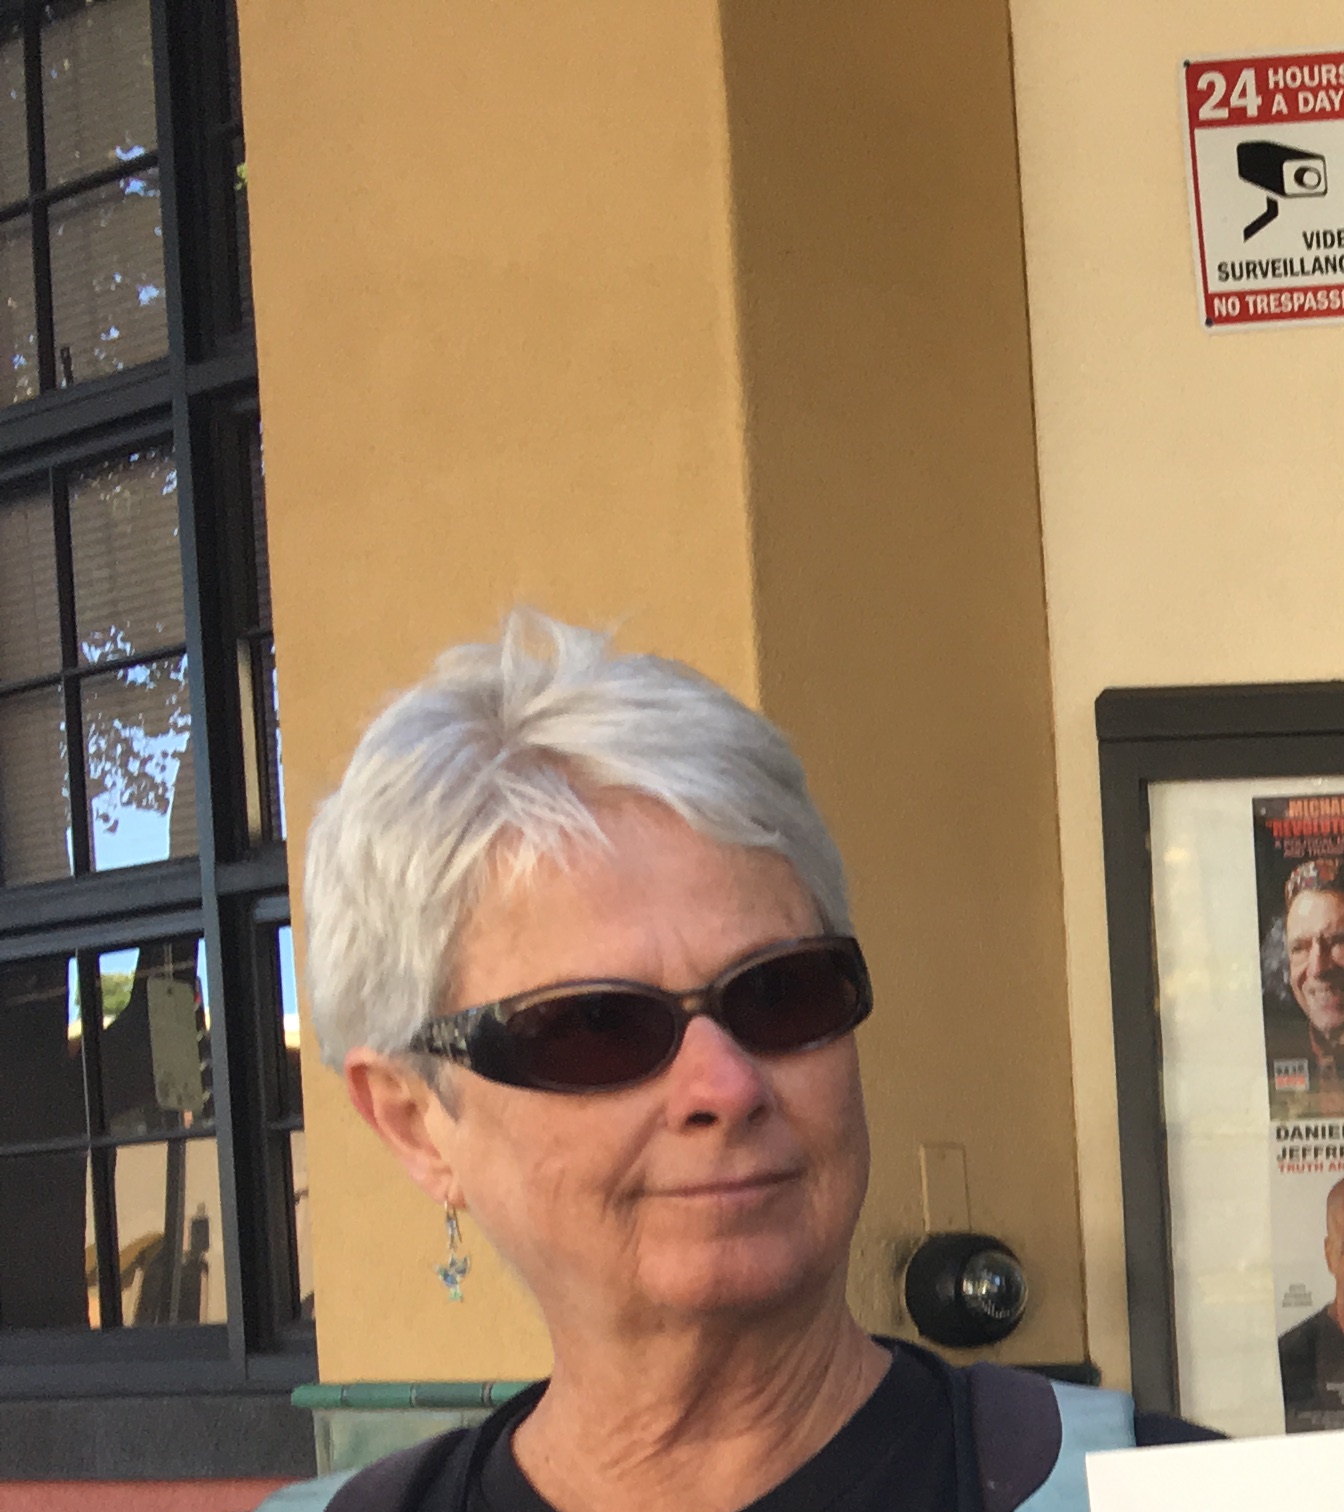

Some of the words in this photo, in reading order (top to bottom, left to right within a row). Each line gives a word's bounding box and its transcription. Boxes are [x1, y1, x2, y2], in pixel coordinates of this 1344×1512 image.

[1197, 68, 1262, 121] 24
[1271, 93, 1288, 115] A
[1298, 88, 1344, 114] DAY
[1214, 296, 1240, 317] NO
[1279, 1162, 1324, 1173] TRUTH
